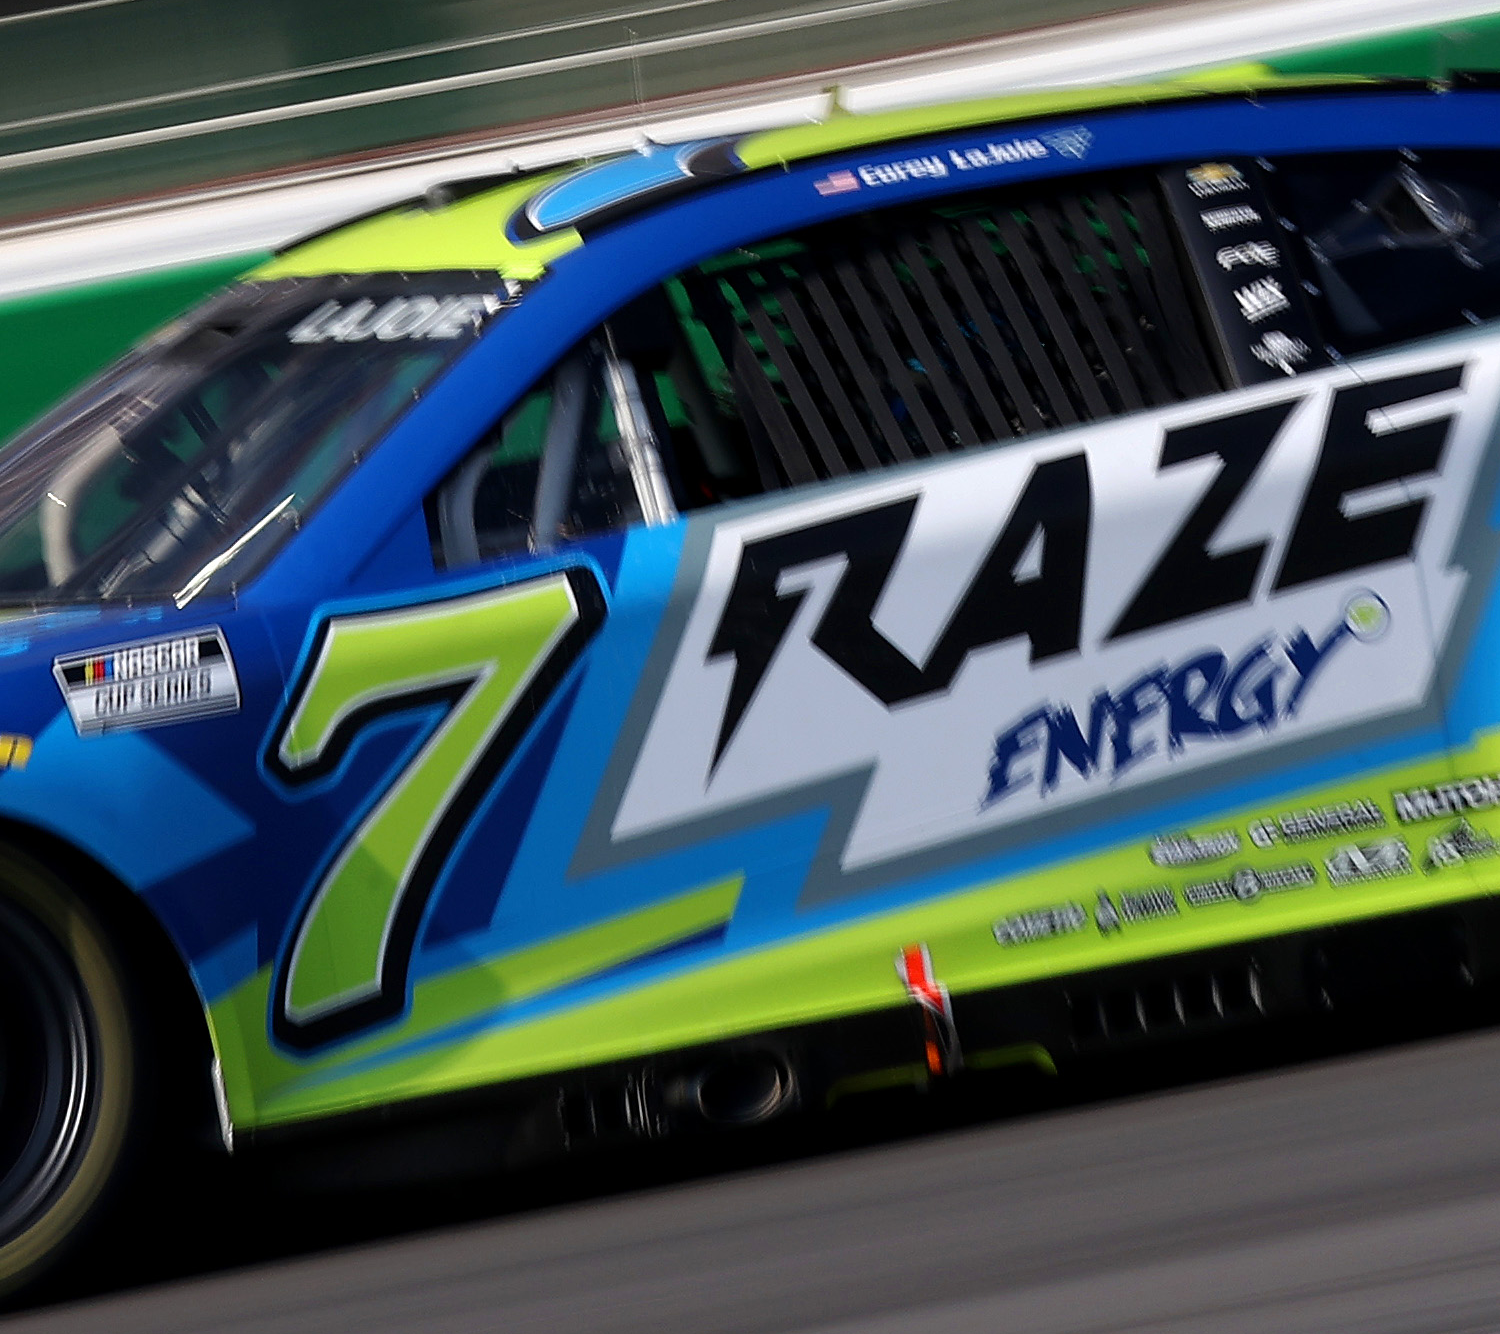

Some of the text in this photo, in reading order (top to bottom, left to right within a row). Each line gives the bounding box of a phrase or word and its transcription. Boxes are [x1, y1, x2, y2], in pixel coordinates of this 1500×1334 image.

[112, 636, 200, 682] NASCAR
[704, 359, 1467, 793] RAZE
[978, 607, 1368, 812] ENERGY
[270, 566, 603, 1049] 7
